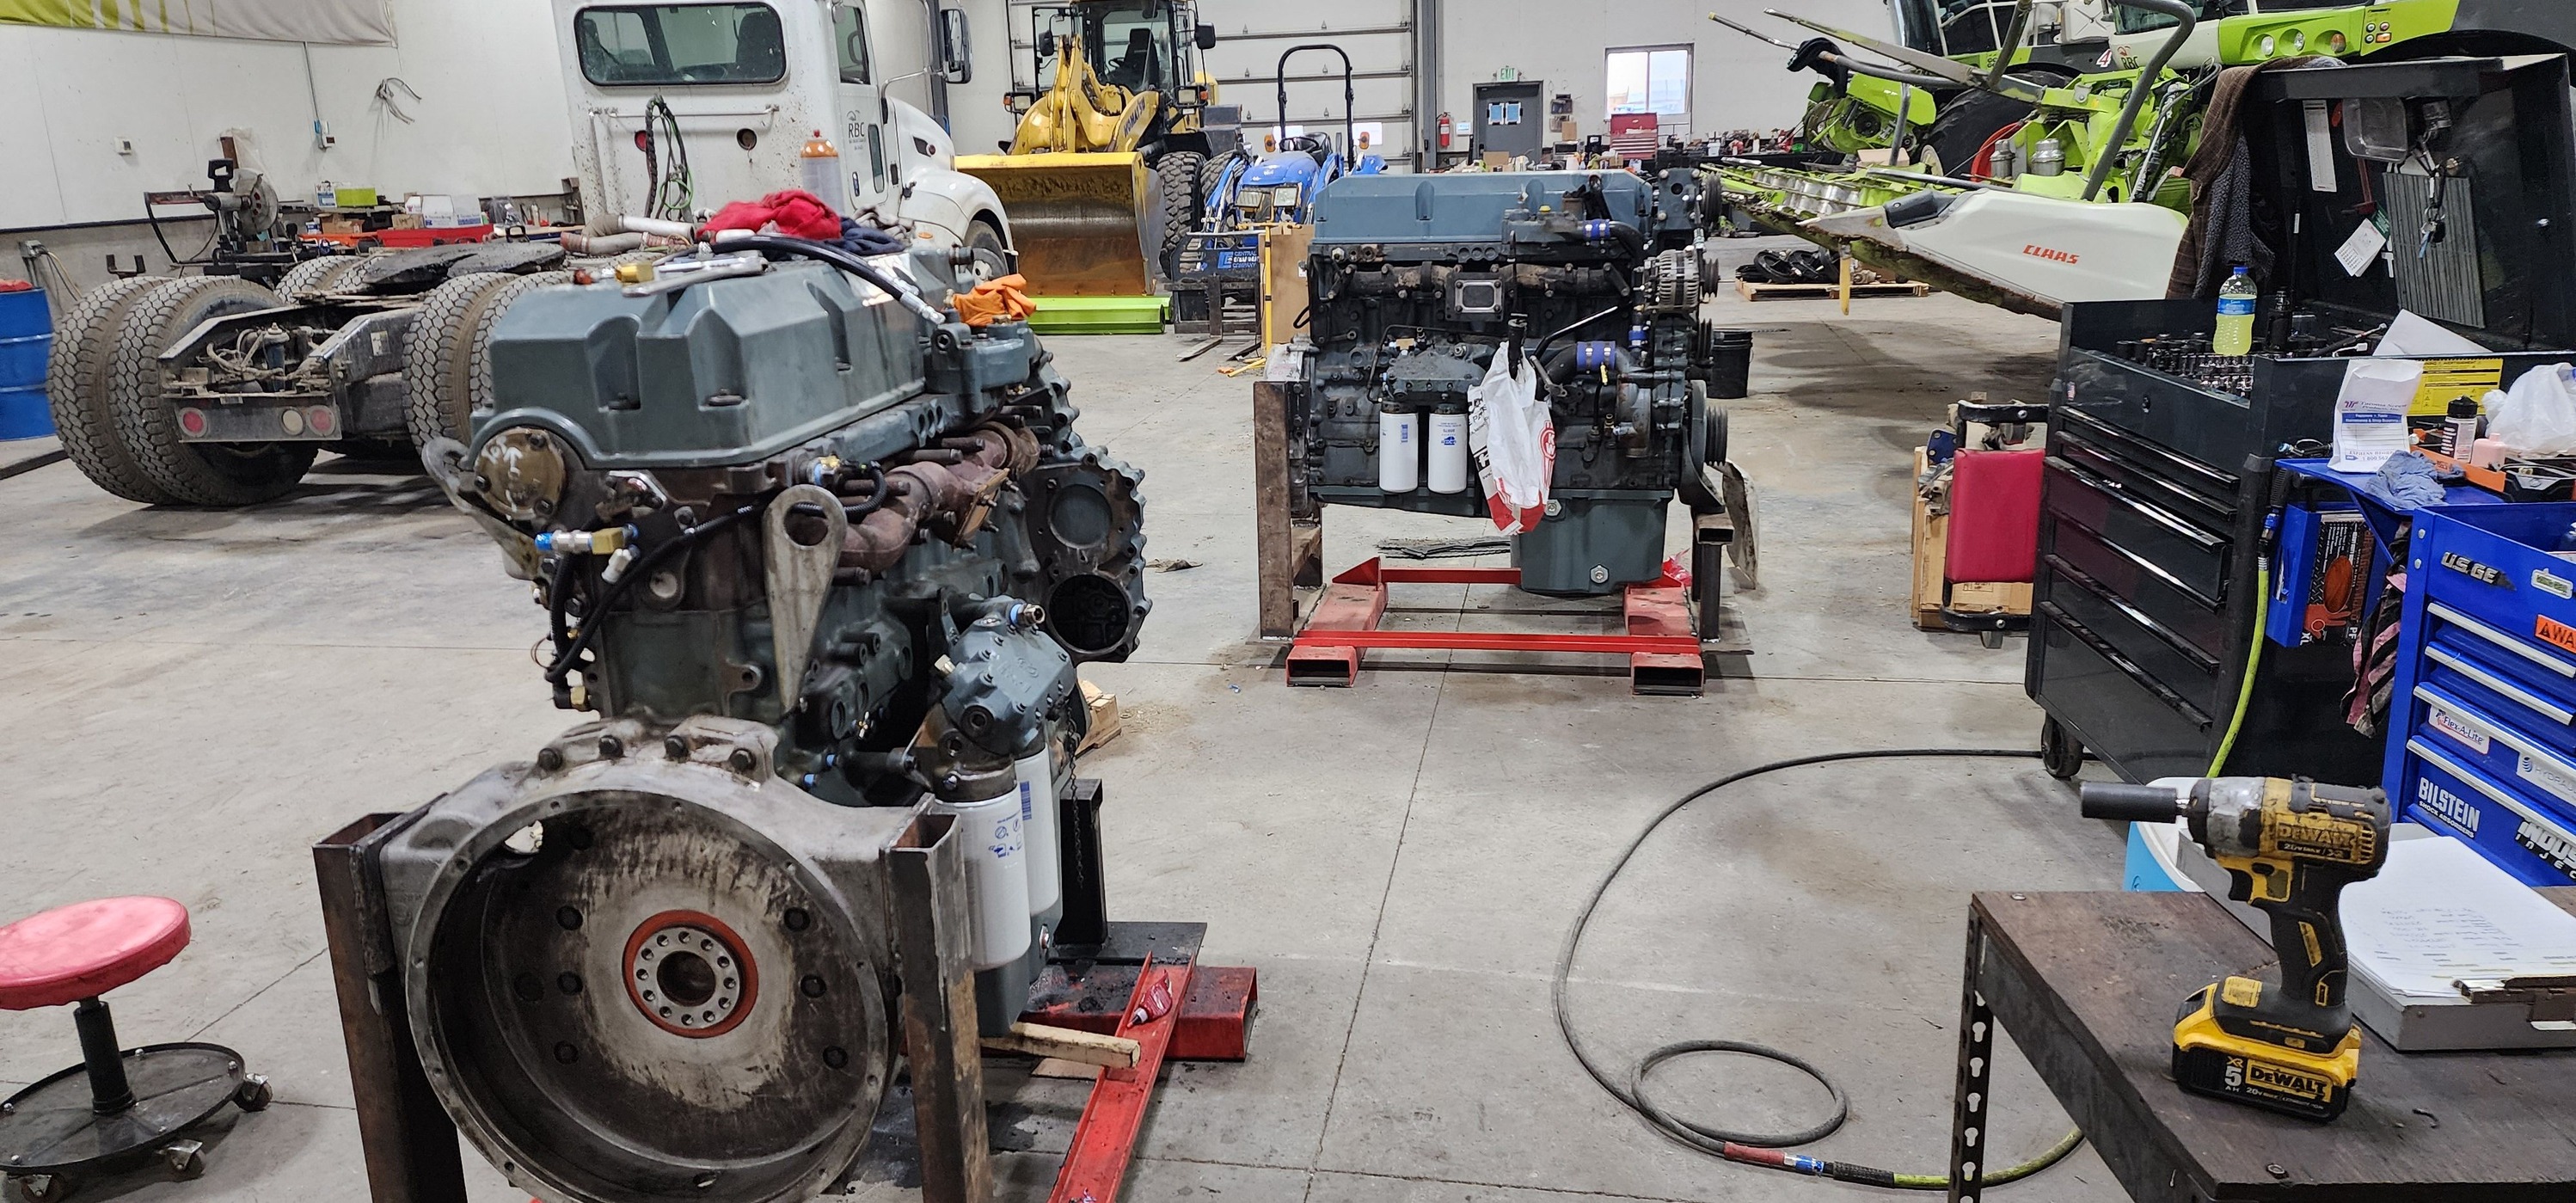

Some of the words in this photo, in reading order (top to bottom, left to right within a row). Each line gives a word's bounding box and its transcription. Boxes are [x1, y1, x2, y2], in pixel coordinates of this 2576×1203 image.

[2096, 49, 2113, 68] 4
[1500, 68, 1515, 80] EXIT
[848, 122, 865, 138] RBC
[2022, 244, 2080, 264] CLAAS
[2300, 632, 2311, 645] XL
[2418, 776, 2481, 832] BILSTEIN
[2419, 800, 2439, 817] SHOCK
[2227, 1056, 2244, 1068] XR
[2224, 1065, 2242, 1086] 5
